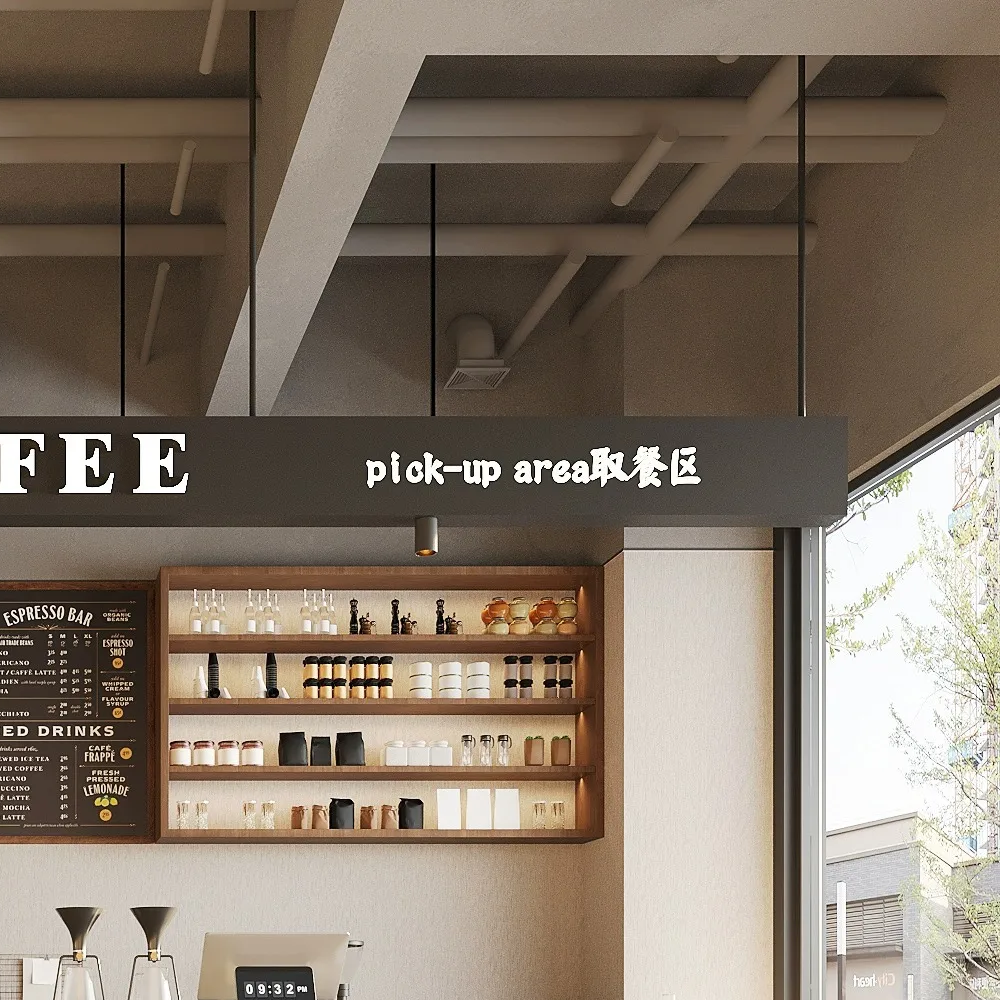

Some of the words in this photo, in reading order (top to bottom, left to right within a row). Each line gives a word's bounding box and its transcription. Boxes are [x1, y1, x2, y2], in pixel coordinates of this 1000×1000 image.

[366, 451, 502, 488] pick-up
[3, 605, 64, 627] ESPRESSO
[67, 608, 93, 627] BAR
[103, 639, 133, 647] ESPRESSO
[110, 648, 126, 656] SHOT
[38, 726, 114, 737] DRINKS
[83, 784, 130, 797] LEMONADE
[246, 984, 294, 994] 09:32
